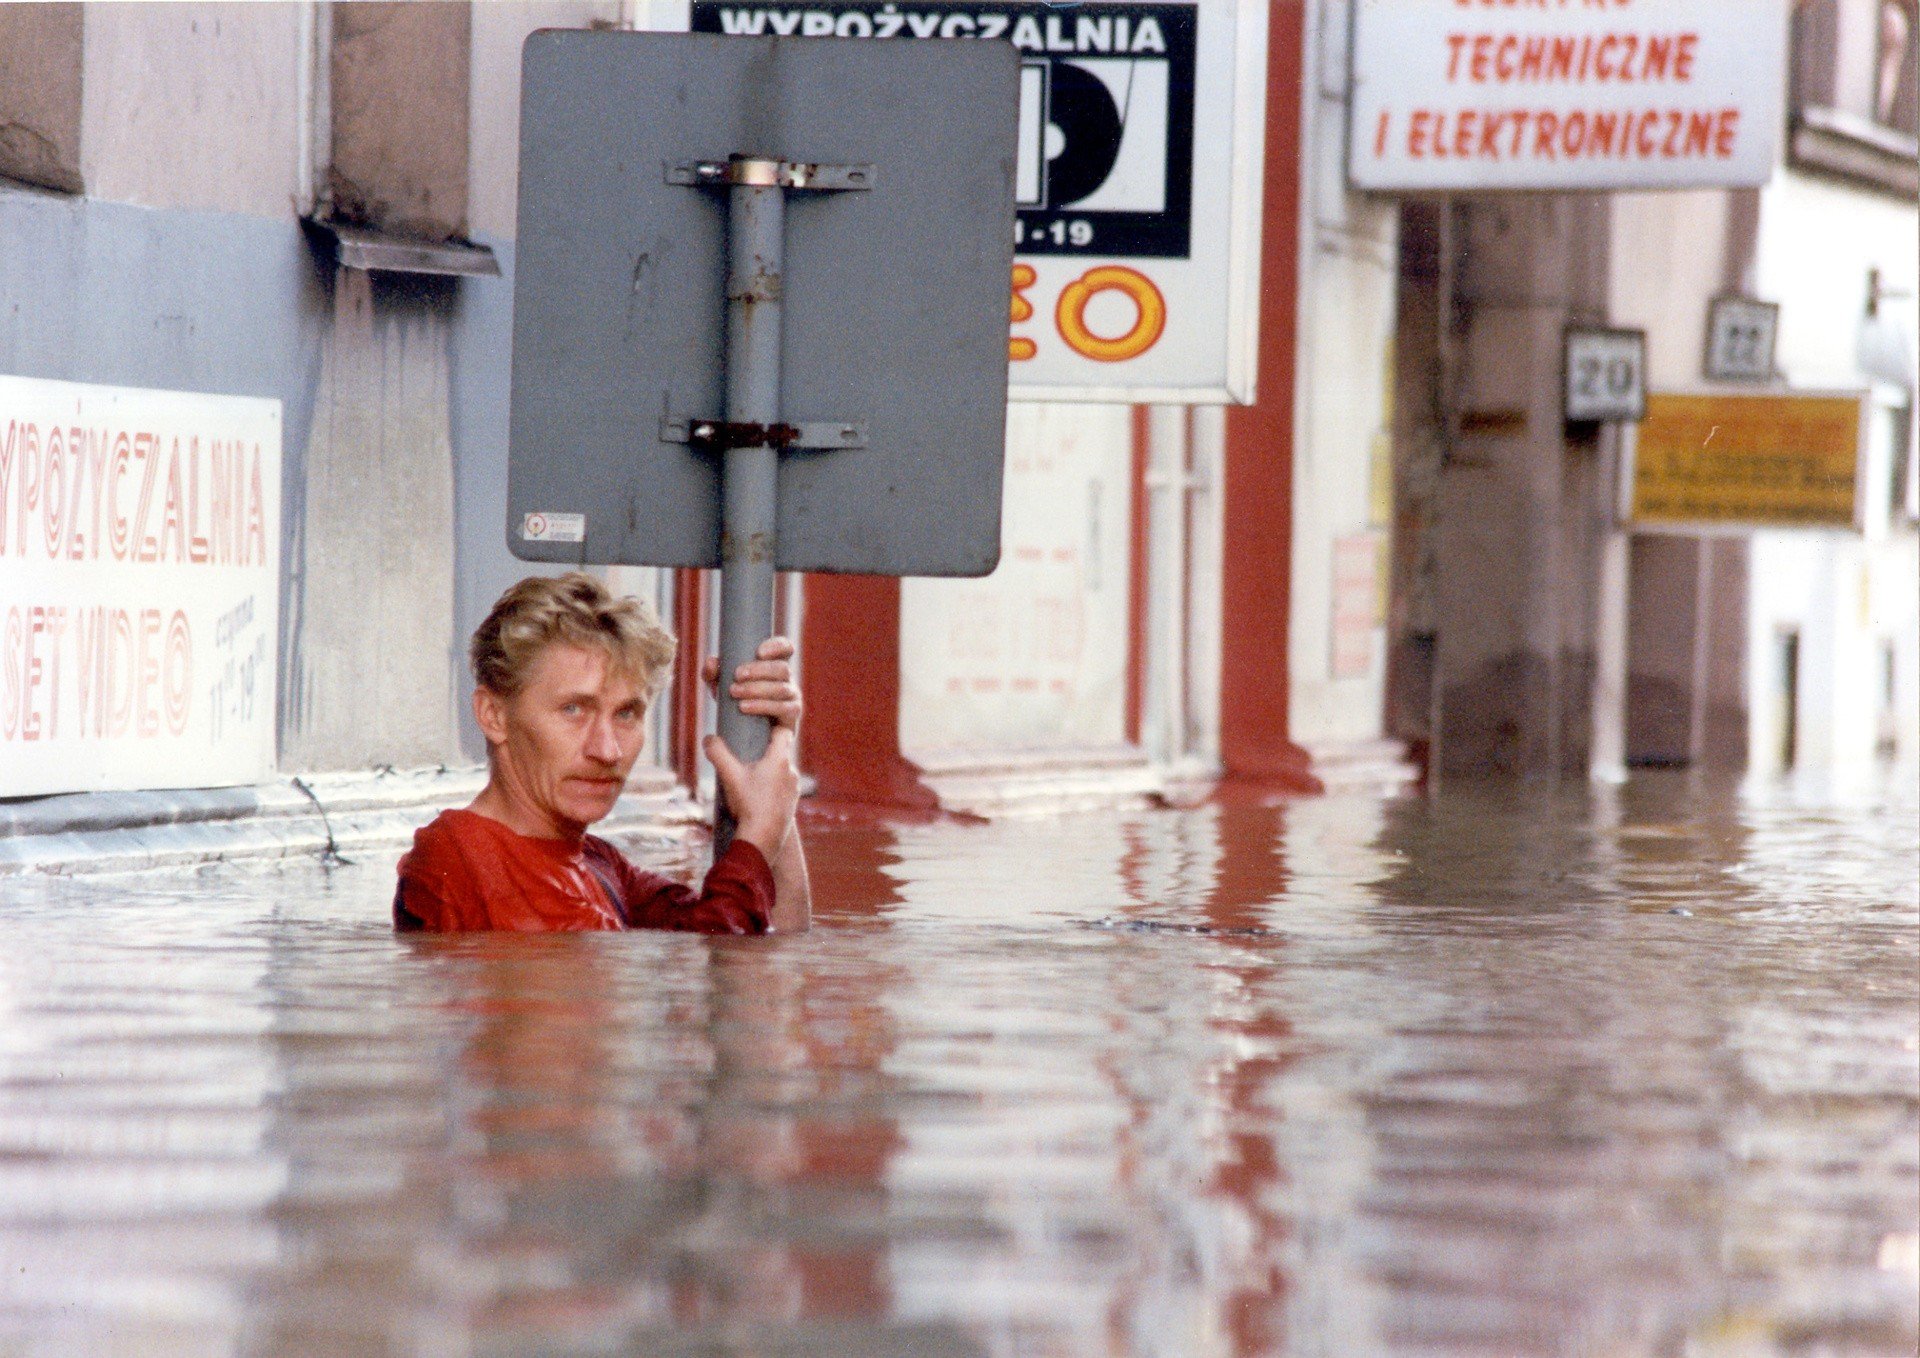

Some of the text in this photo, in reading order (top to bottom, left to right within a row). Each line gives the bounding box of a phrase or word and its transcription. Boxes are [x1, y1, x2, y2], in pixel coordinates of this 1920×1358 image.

[1447, 34, 1698, 84] TECHNICZNE
[1375, 109, 1739, 160] I ELEKTRONICZNE
[1576, 355, 1635, 398] 20
[3, 604, 193, 741] SET VIDEO
